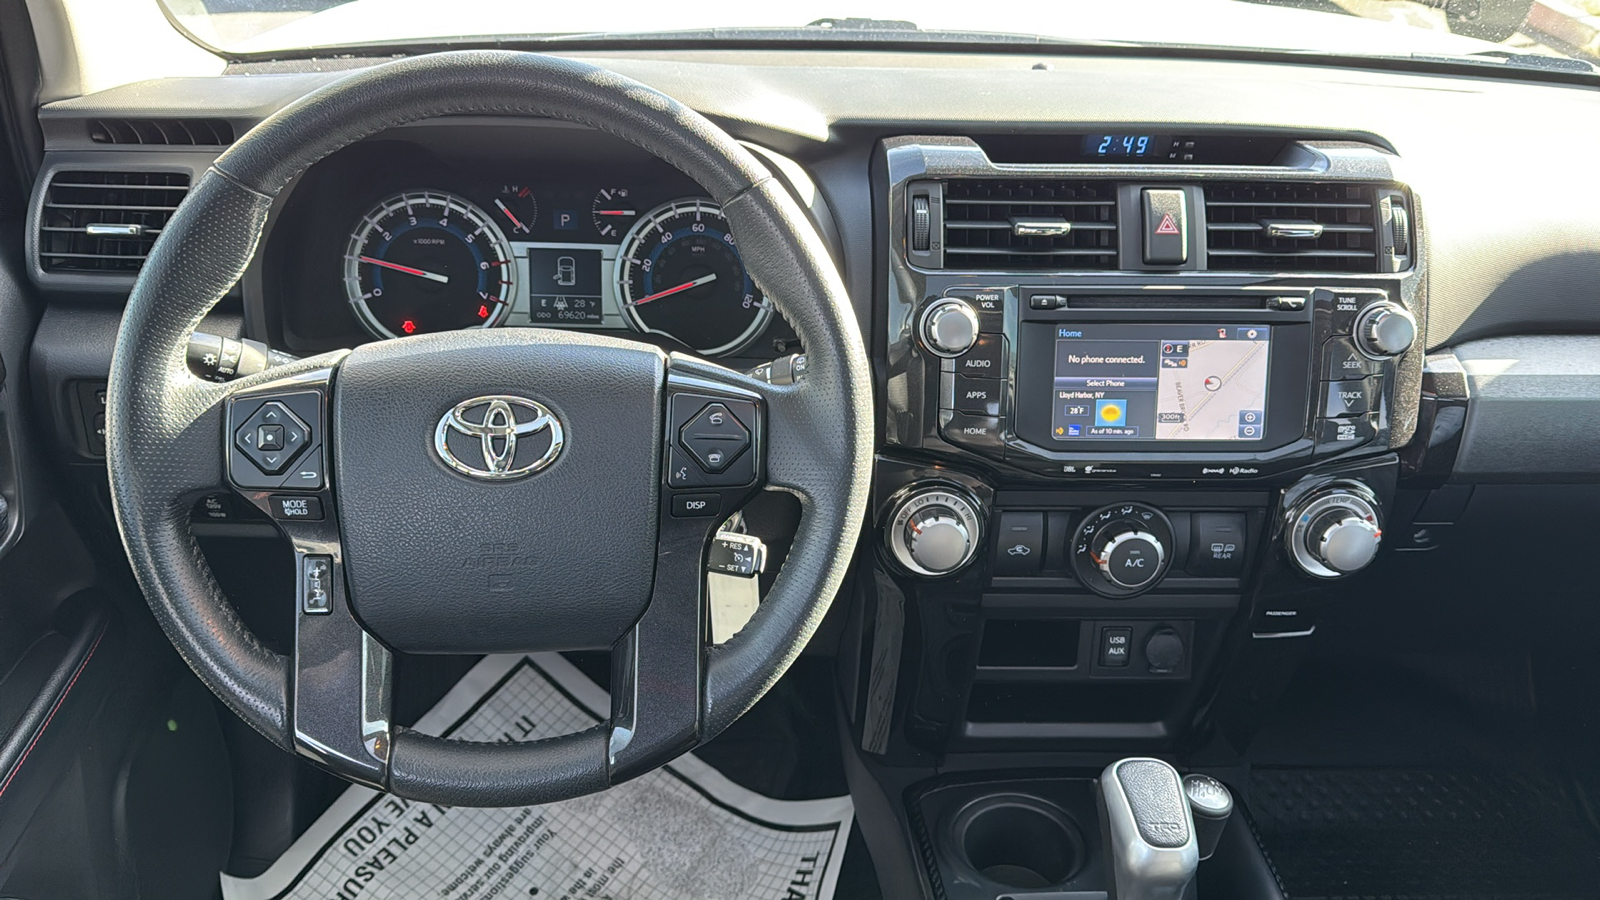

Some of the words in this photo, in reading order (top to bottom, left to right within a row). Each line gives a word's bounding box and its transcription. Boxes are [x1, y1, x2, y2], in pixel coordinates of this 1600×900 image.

[1098, 135, 1149, 154] 2:49
[409, 217, 417, 226] 3
[439, 218, 448, 227] 4
[560, 214, 571, 226] P
[692, 223, 705, 232] 60
[382, 231, 392, 241] 2
[465, 234, 475, 243] 5
[661, 231, 673, 244] 40
[480, 261, 490, 270] 6
[641, 258, 652, 272] 20
[373, 287, 382, 297] 0
[541, 299, 547, 307] E
[574, 299, 586, 308] 28
[558, 311, 586, 320] 69620
[1058, 328, 1083, 338] Home
[1176, 345, 1183, 353] E
[965, 359, 991, 367] AUDIO
[1068, 354, 1080, 363] No
[1081, 354, 1104, 365] phone
[1105, 354, 1146, 364] connected.
[217, 366, 235, 375] AUTO
[966, 391, 987, 399] APPS
[1338, 391, 1362, 399] TRACK
[282, 499, 307, 508] MODE
[686, 501, 706, 509] DISP
[902, 507, 913, 519] OFF
[914, 498, 925, 508] LO
[729, 542, 742, 551] RES
[1125, 558, 1145, 567] A/C
[726, 563, 739, 572] SET
[1109, 636, 1126, 644] USB
[1108, 647, 1125, 655] AUX
[514, 715, 536, 738] IT
[412, 810, 434, 829] A
[514, 807, 532, 825] are
[343, 816, 391, 857] YOU
[482, 824, 516, 858] always
[499, 815, 548, 864] improving
[533, 828, 557, 851] Your
[484, 862, 502, 880] our
